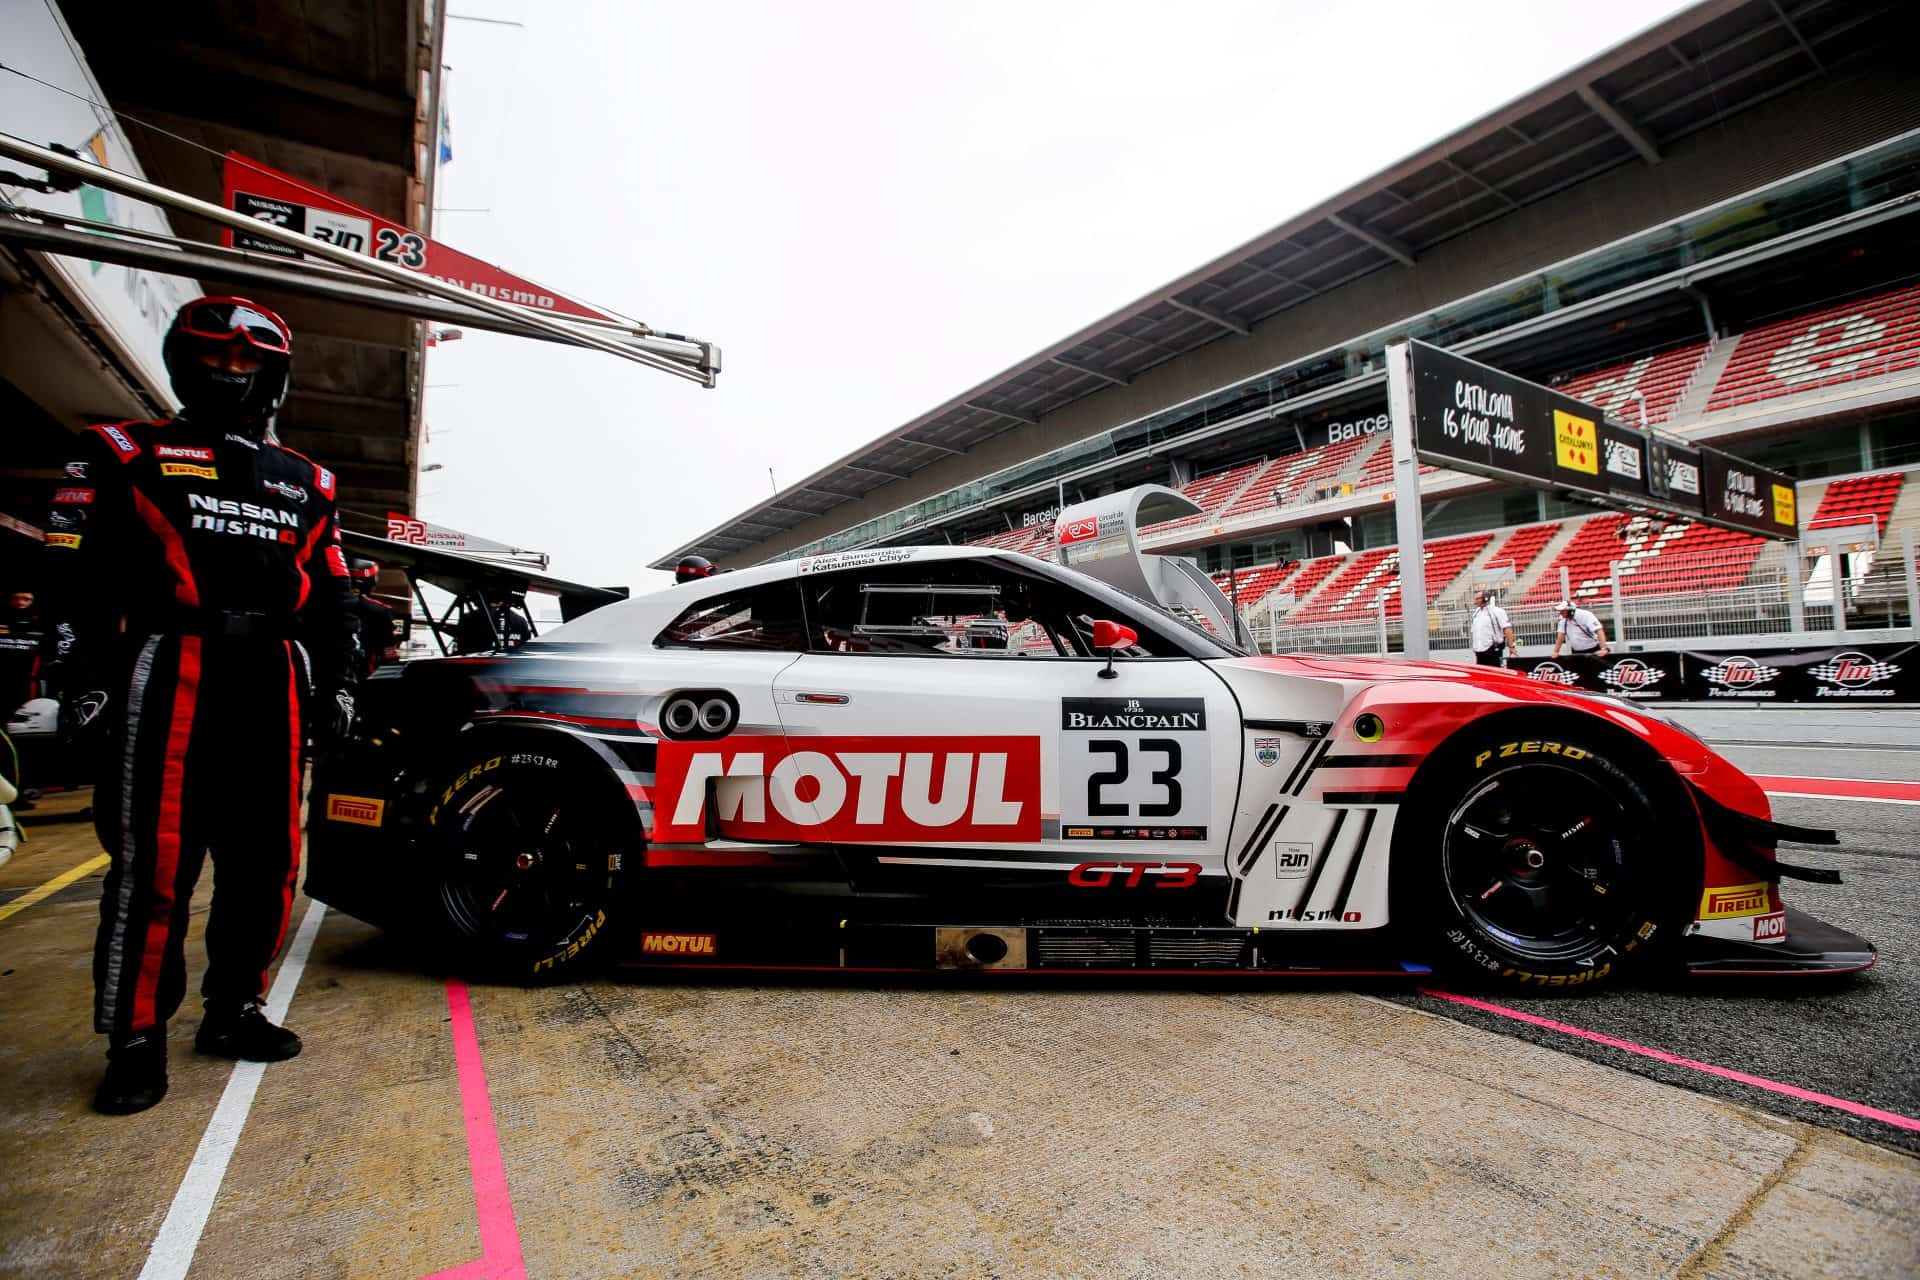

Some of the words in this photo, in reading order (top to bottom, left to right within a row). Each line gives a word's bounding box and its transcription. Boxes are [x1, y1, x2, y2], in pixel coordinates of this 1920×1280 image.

[376, 229, 427, 269] 23
[470, 282, 555, 309] nismo
[1443, 408, 1459, 438] IS
[1461, 411, 1492, 445] YOUR
[1492, 422, 1526, 455] HOME
[159, 446, 209, 459] MOTUL
[187, 494, 299, 528] NISSAN
[387, 519, 427, 547] 22
[426, 532, 466, 542] NISSAN
[812, 557, 875, 572] Katsumasa
[878, 552, 911, 563] Chiyo
[1067, 713, 1200, 728] BLANCPAIN
[1475, 750, 1492, 769] P
[1499, 741, 1587, 760] ZERO
[442, 756, 502, 806] ZERO
[671, 751, 1024, 827] MOTUL
[1087, 738, 1183, 817] 23
[1280, 853, 1309, 867] RJN
[1067, 861, 1203, 888] GT3
[1708, 888, 1764, 913] PIRELLI
[533, 909, 606, 973] PIRELLI
[642, 935, 714, 954] MOTUL
[1502, 962, 1611, 987] PIRELLI
